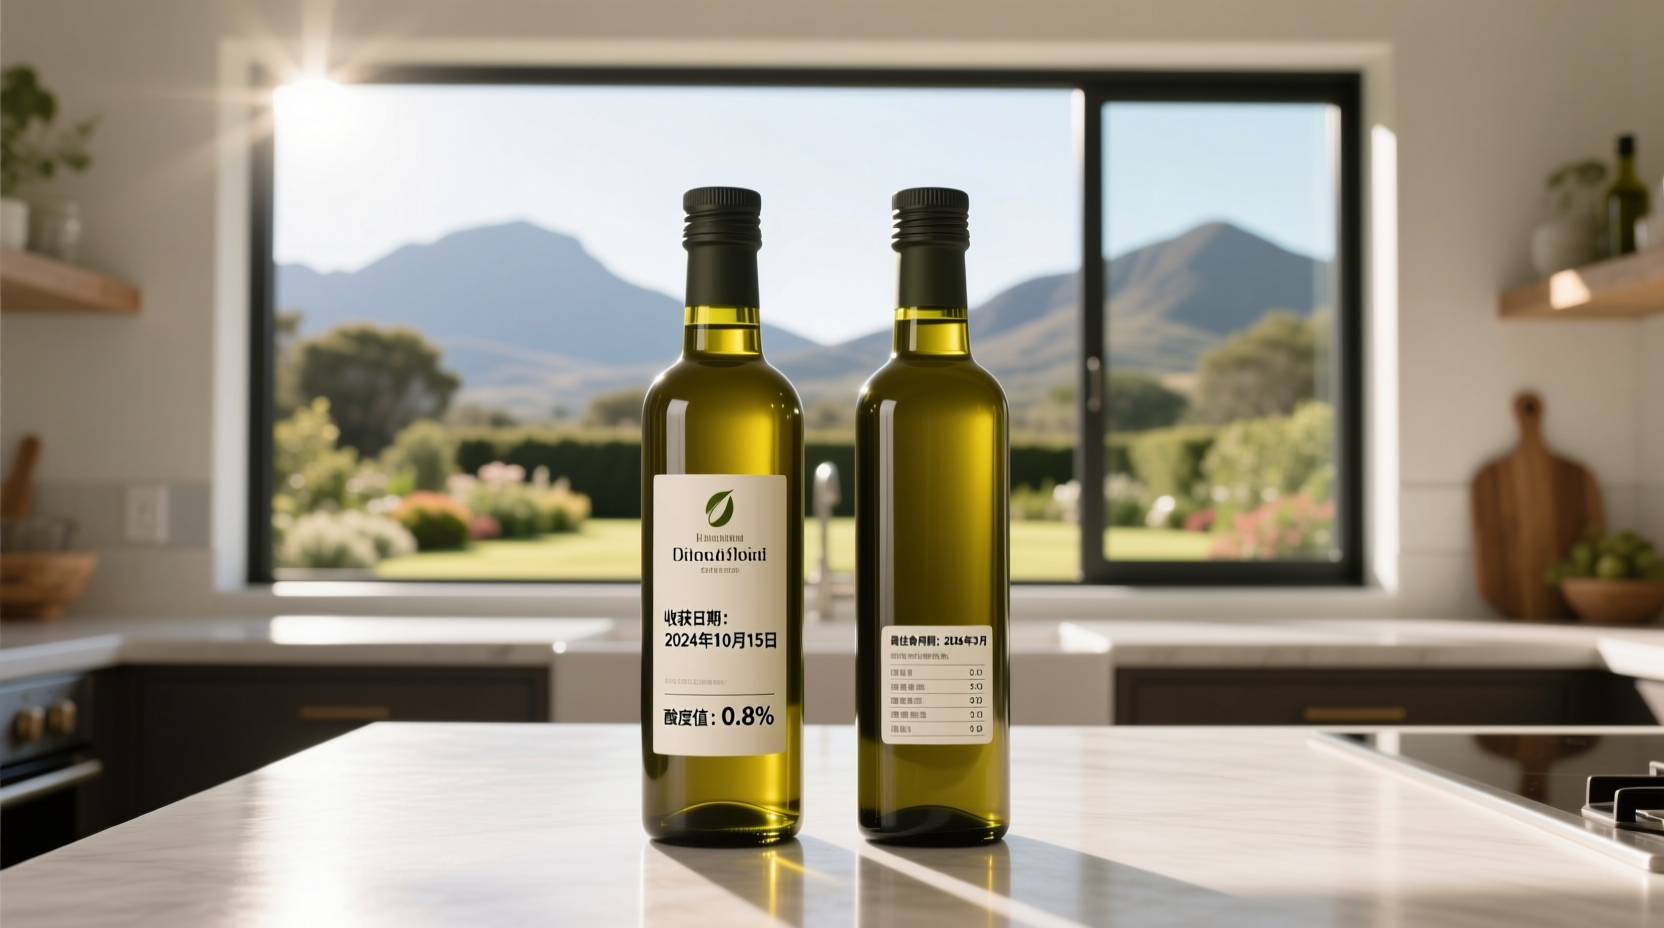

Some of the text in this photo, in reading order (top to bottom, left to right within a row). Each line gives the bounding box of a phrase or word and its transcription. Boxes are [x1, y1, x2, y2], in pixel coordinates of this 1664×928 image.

[665, 632, 777, 649] 2024年10月15日
[721, 705, 775, 726] 0.8%
